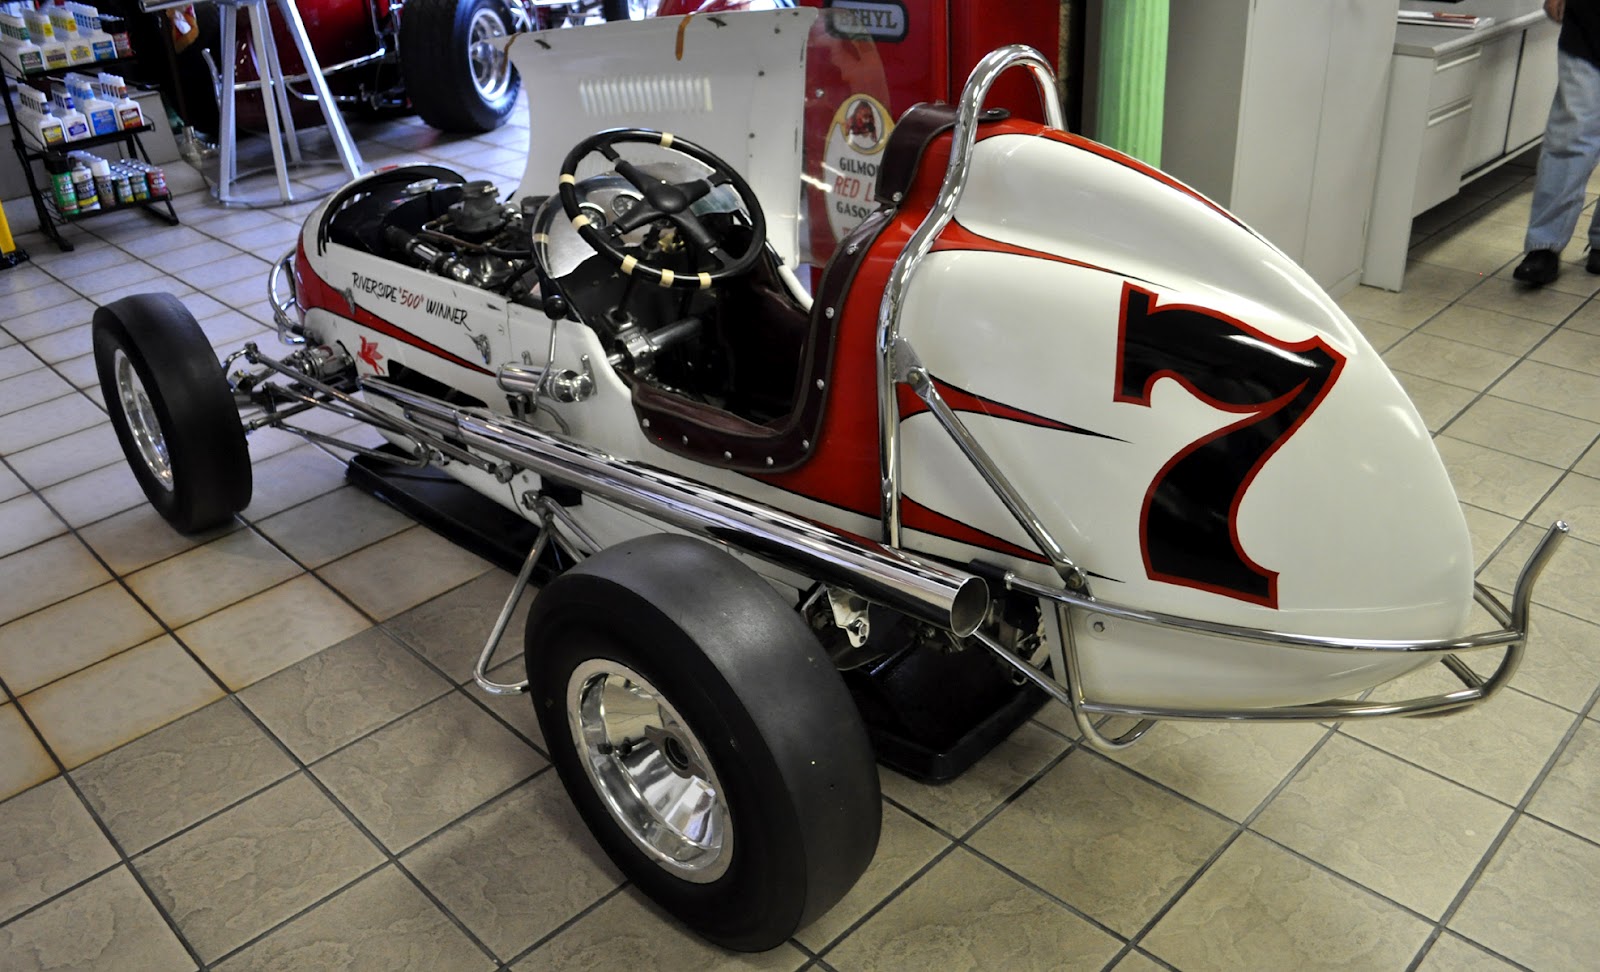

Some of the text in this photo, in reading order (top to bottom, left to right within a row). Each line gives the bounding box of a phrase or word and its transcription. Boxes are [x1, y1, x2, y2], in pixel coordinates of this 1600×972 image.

[839, 157, 880, 177] GILMO
[834, 176, 861, 198] RED
[836, 201, 871, 219] GASO
[352, 272, 397, 302] RIVERSIDE
[426, 299, 472, 332] WINNER
[1113, 281, 1347, 610] 7
